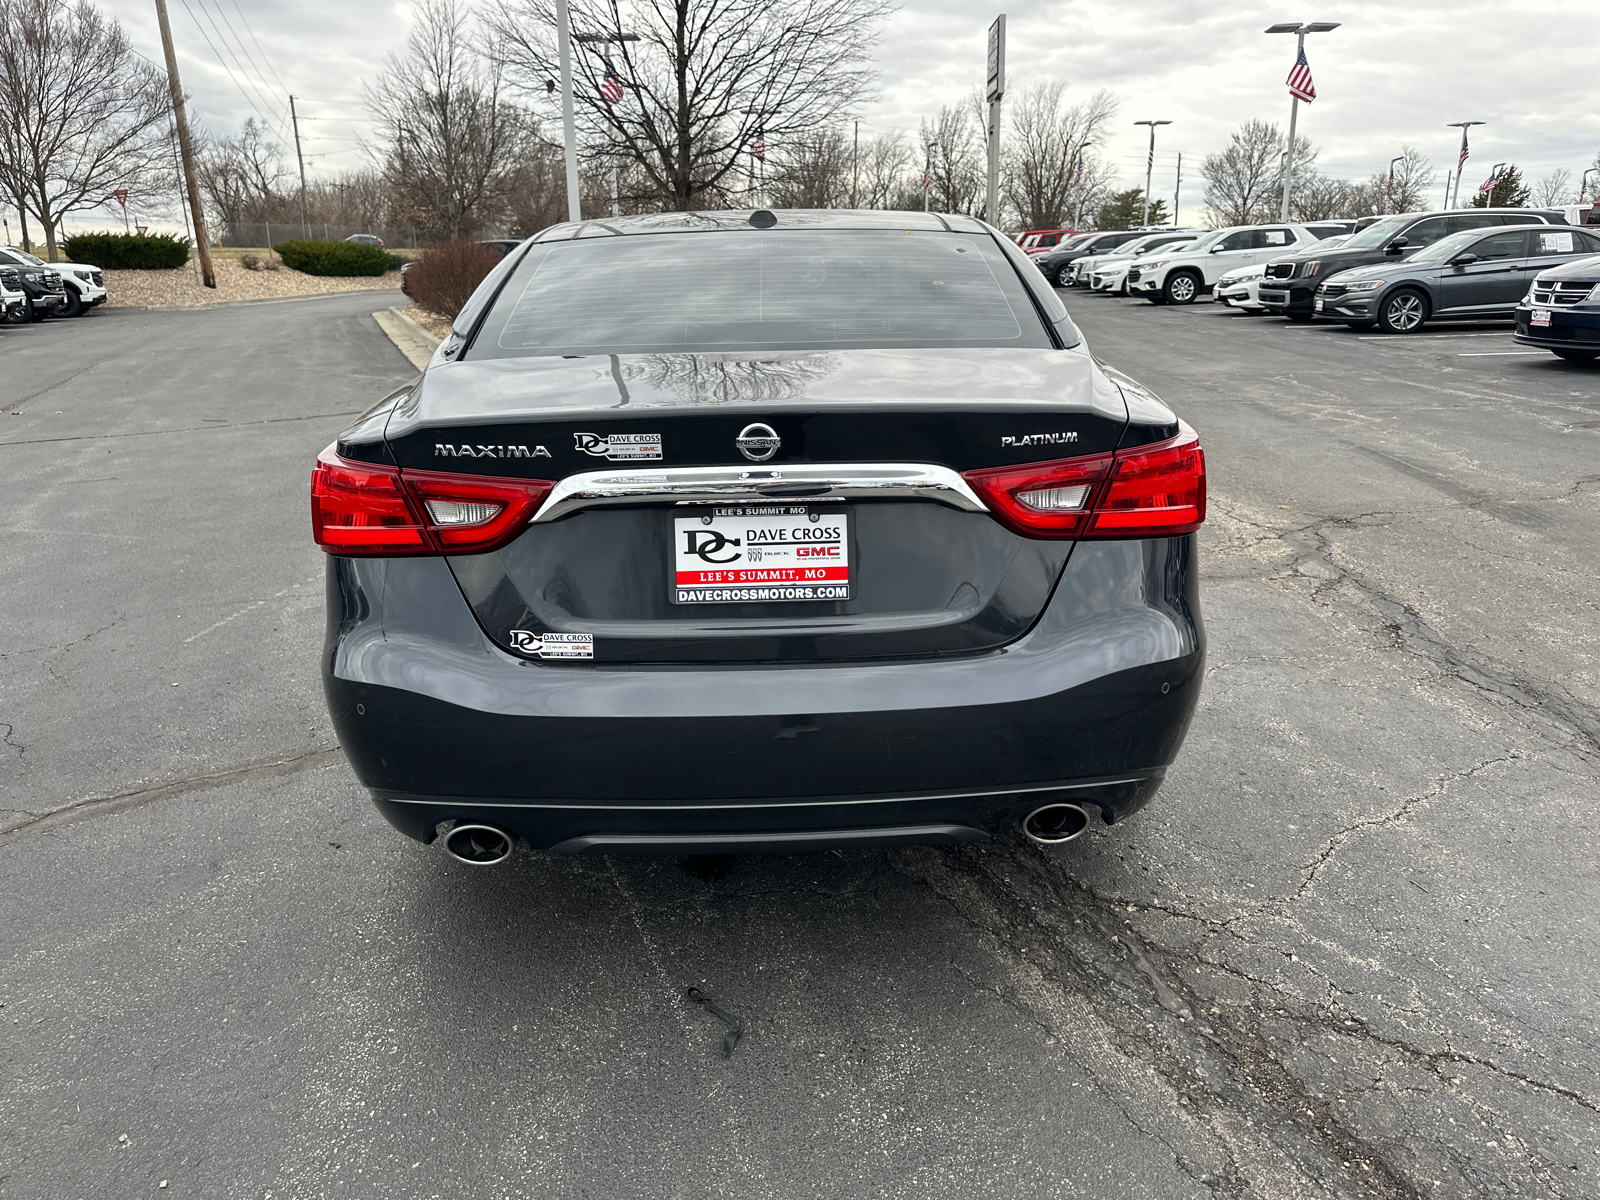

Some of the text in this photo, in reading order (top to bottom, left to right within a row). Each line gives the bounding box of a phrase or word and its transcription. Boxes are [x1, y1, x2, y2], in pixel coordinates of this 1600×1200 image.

[1001, 432, 1078, 447] PLATINUM
[434, 444, 552, 458] MAXIMA
[746, 527, 840, 542] DAVE CROSS
[796, 546, 840, 556] GMC
[700, 569, 826, 582] LEE'S SUMMIT, MO
[678, 587, 847, 601] DAVECROSSMOTORS.COM
